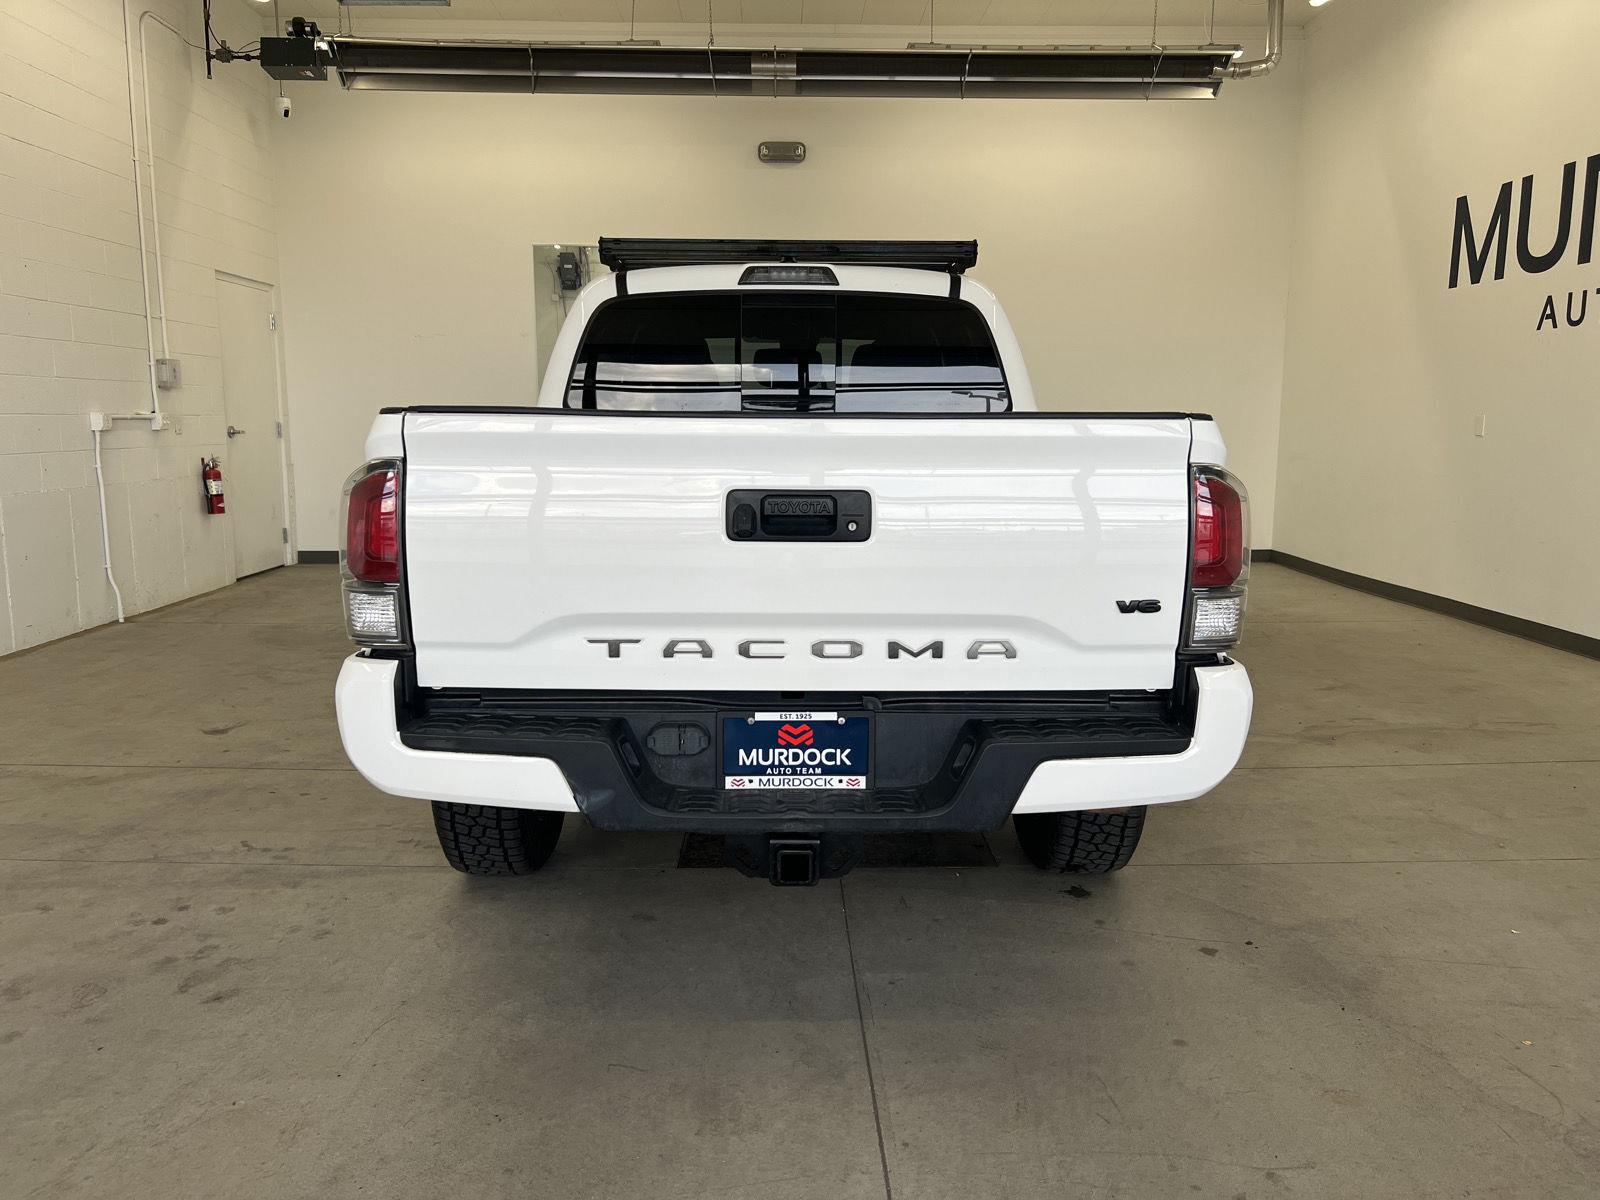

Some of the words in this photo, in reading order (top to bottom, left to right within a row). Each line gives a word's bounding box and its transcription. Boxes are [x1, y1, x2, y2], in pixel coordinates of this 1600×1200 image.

[1536, 287, 1600, 331] AU
[768, 501, 830, 514] TOYOTA
[1115, 599, 1161, 613] V6
[587, 638, 1017, 659] TACOMA
[739, 749, 851, 765] MURDOCK
[758, 778, 833, 787] MURDOCK
